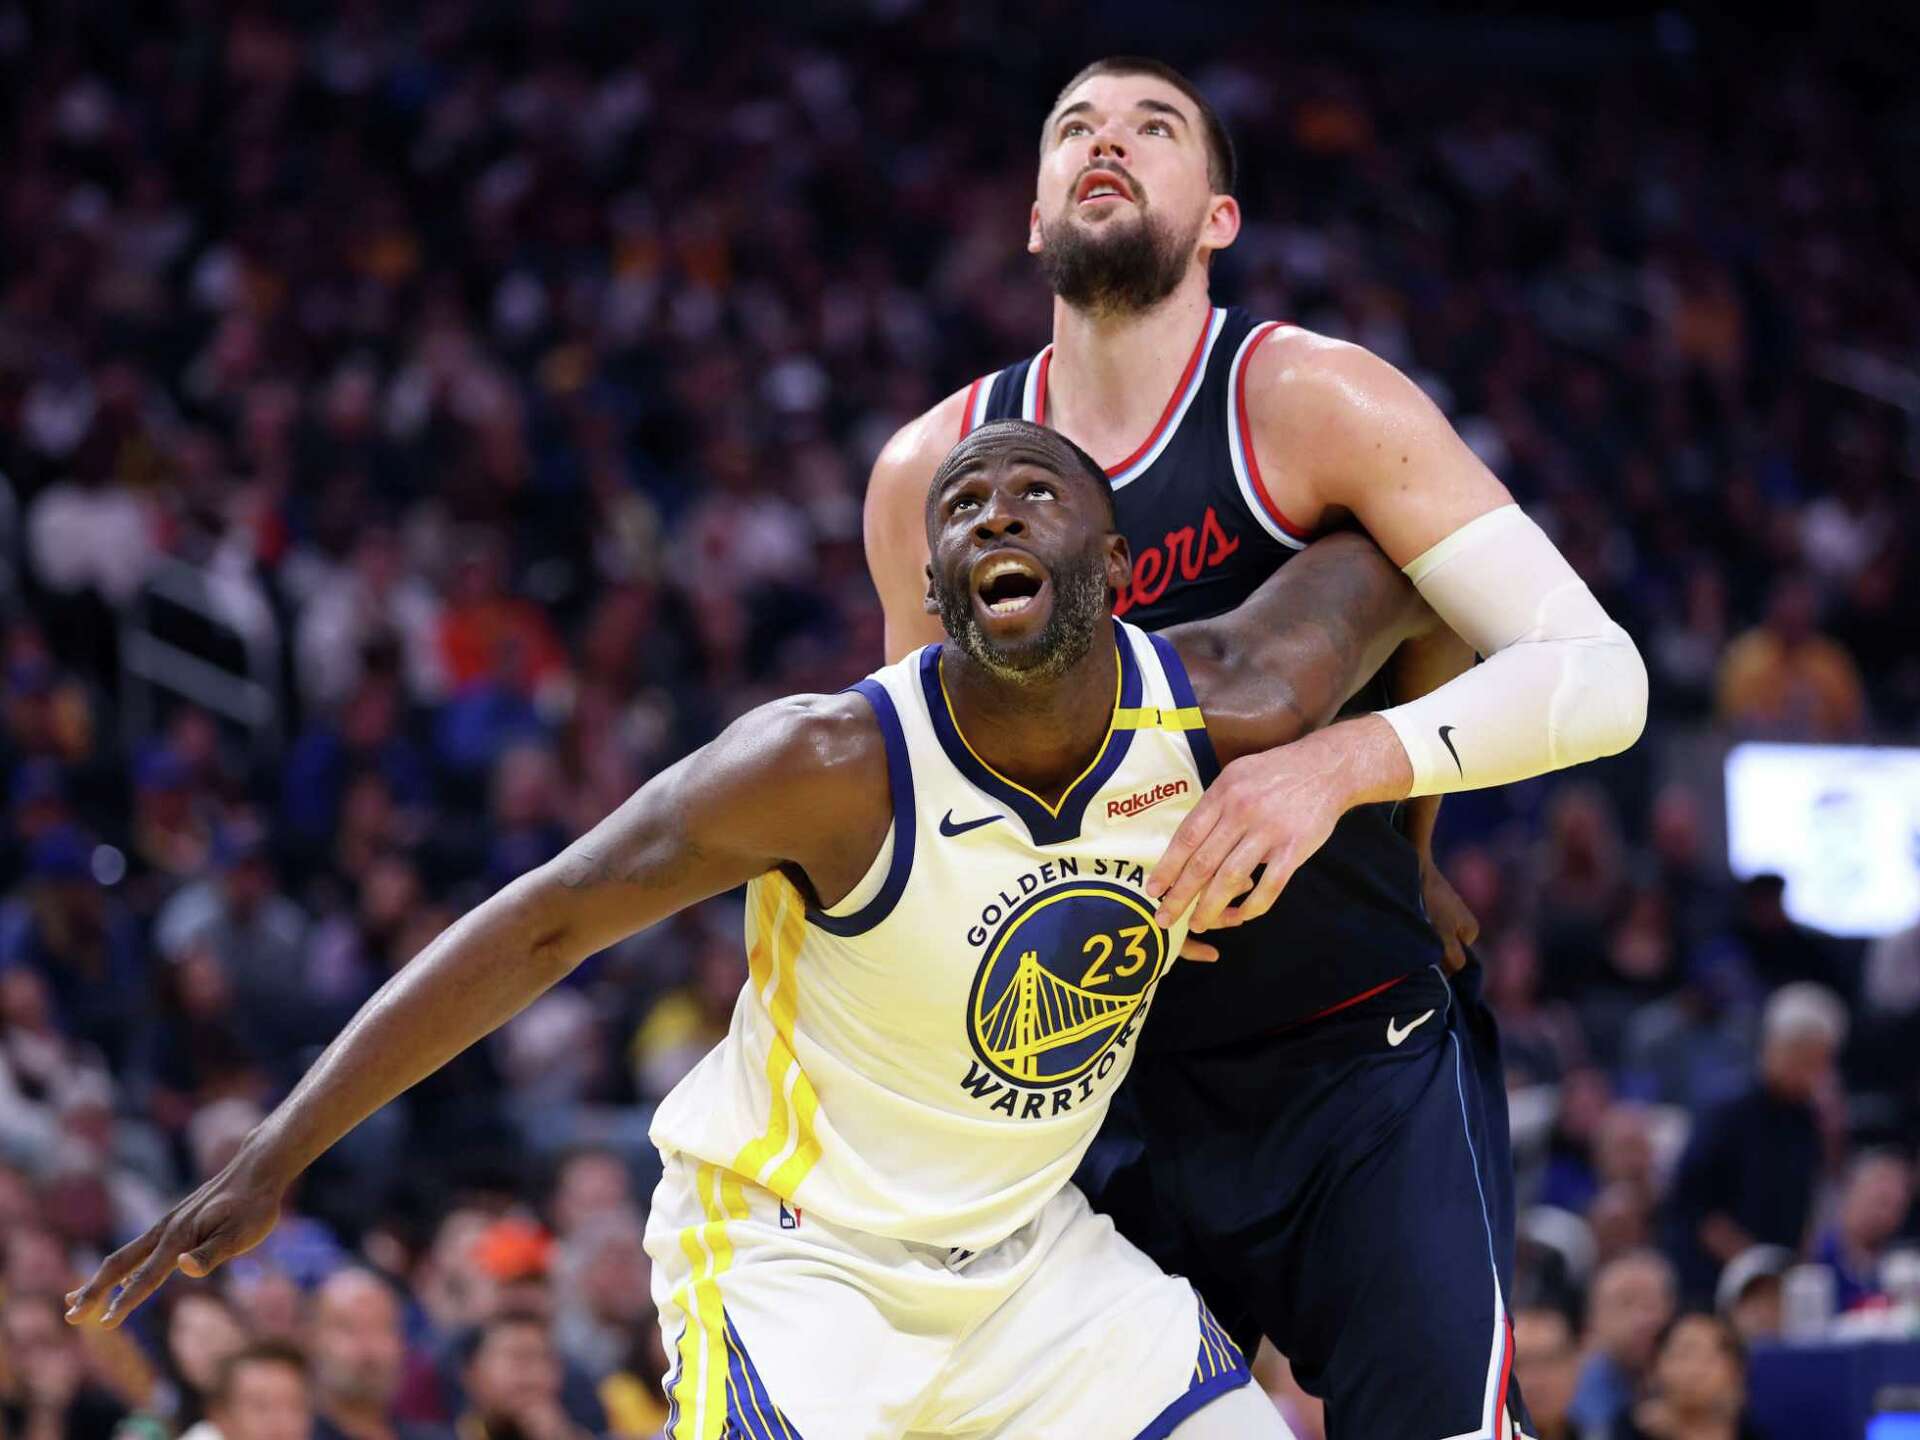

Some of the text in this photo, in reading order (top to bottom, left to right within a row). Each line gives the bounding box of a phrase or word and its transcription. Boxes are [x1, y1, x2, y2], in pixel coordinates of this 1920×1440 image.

[1107, 780, 1188, 818] Rakuten
[967, 857, 1079, 947] GOLDEN
[1080, 925, 1149, 988] 23
[960, 1000, 1148, 1119] WARRIORS
